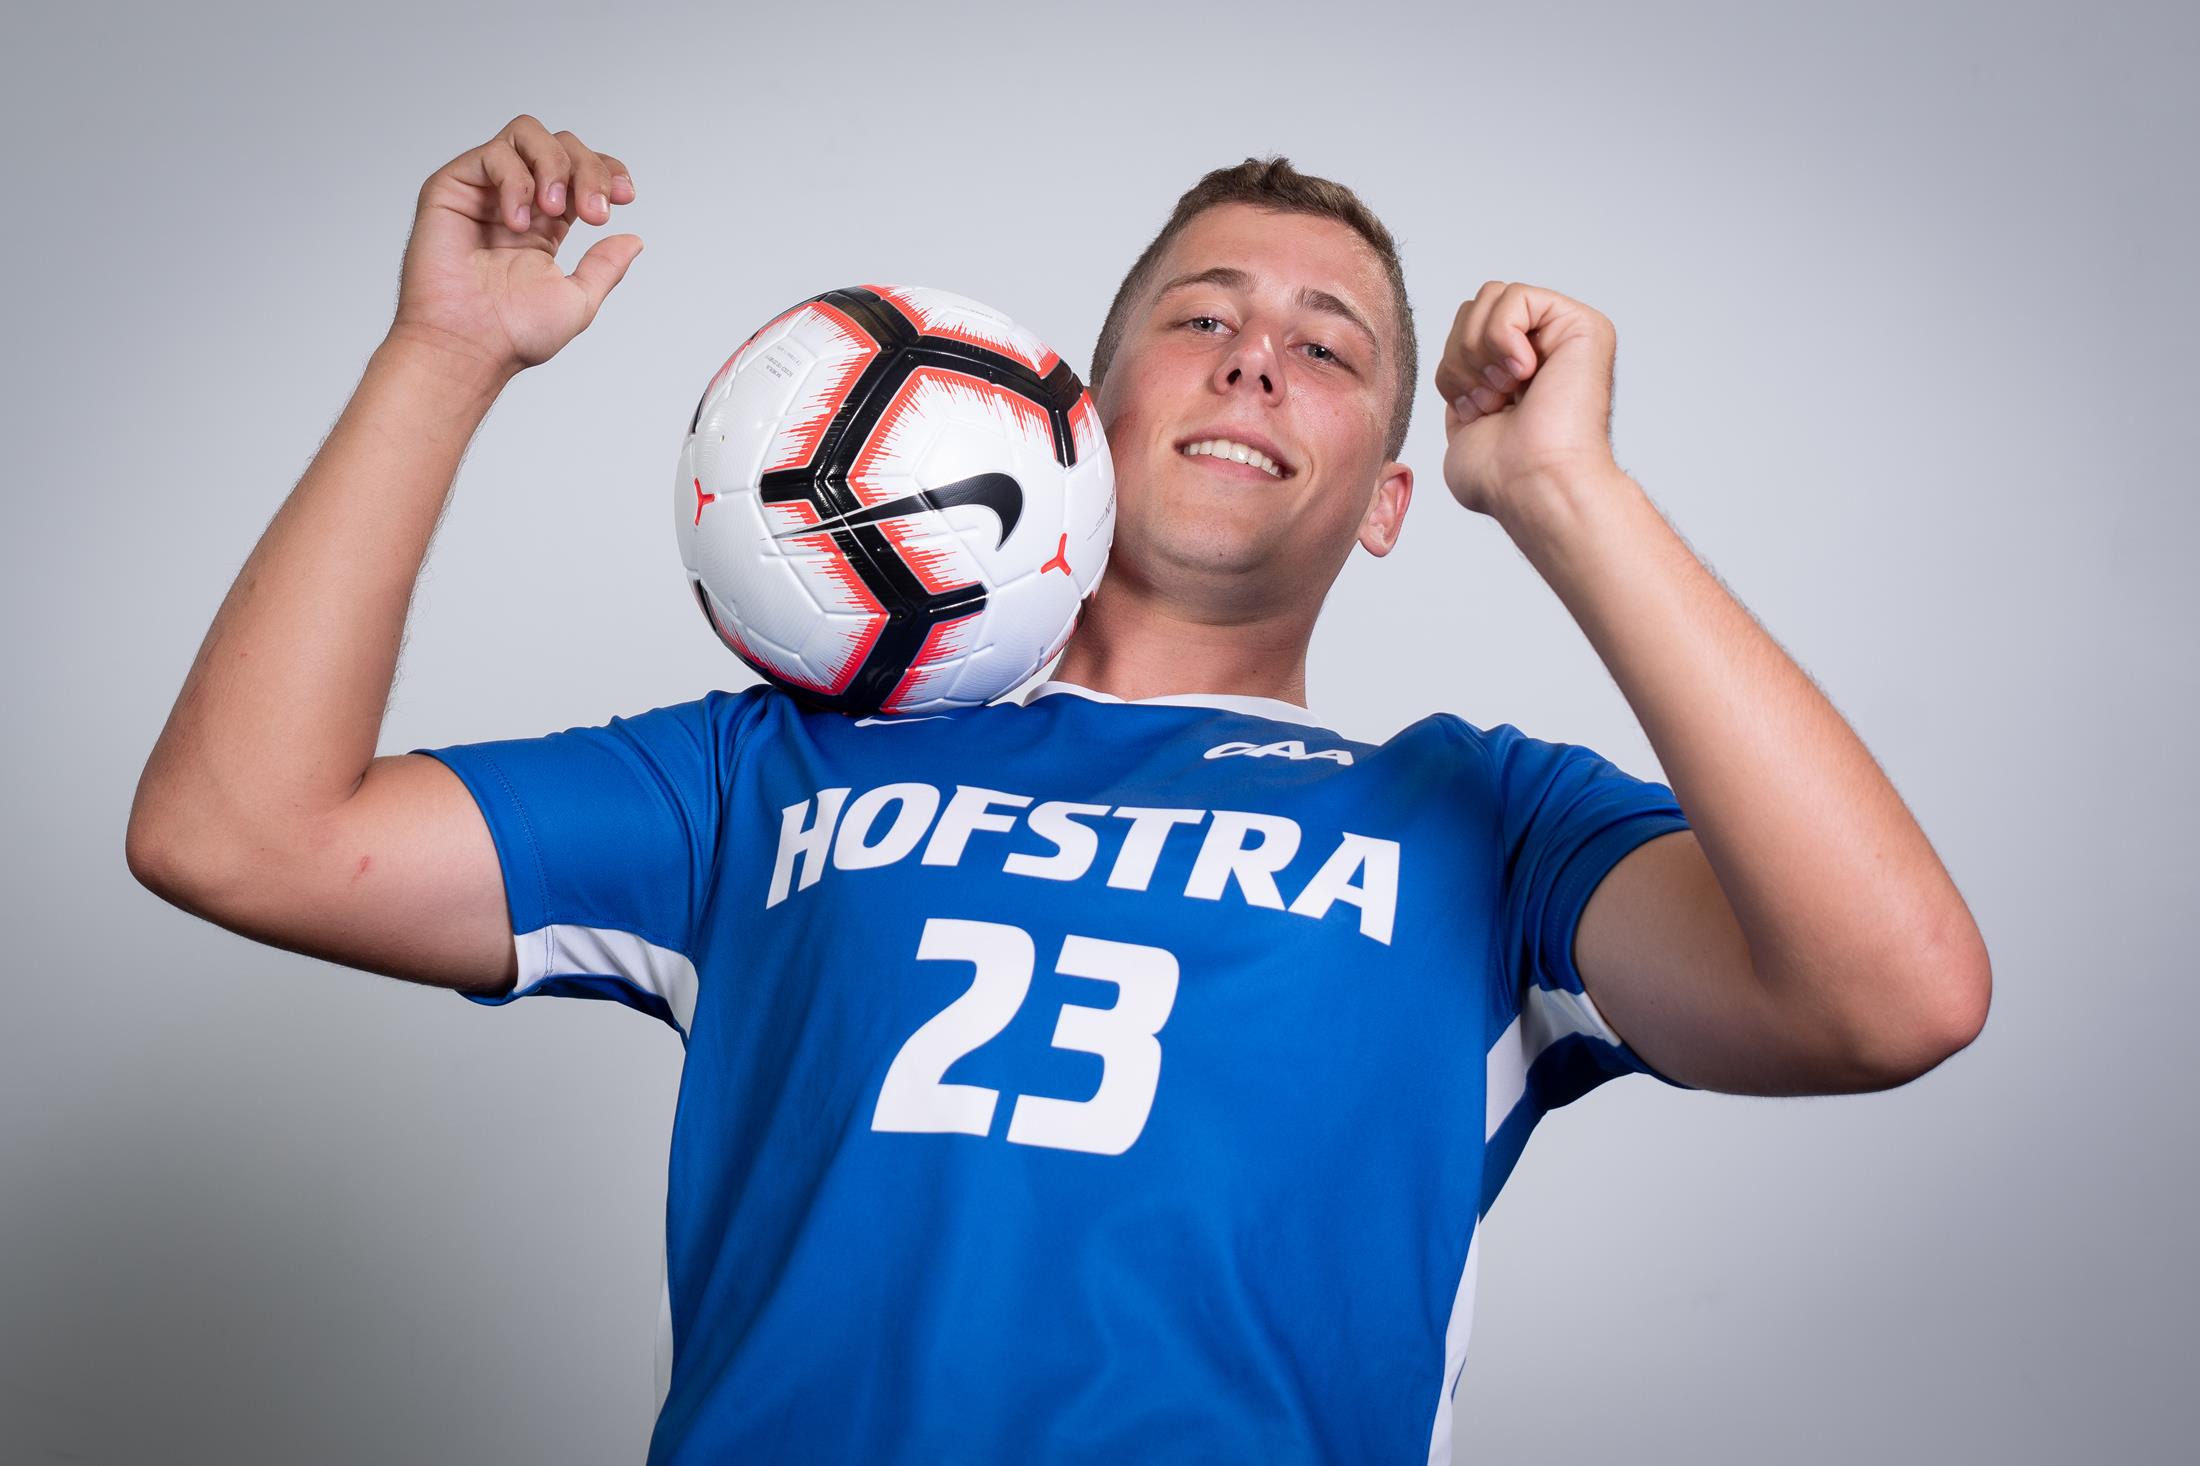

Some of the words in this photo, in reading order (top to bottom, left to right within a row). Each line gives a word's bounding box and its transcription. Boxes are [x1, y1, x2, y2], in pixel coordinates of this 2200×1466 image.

[1203, 740, 1354, 766] CAA
[766, 782, 1400, 946] HOFSTRA
[871, 918, 1180, 1156] 23
